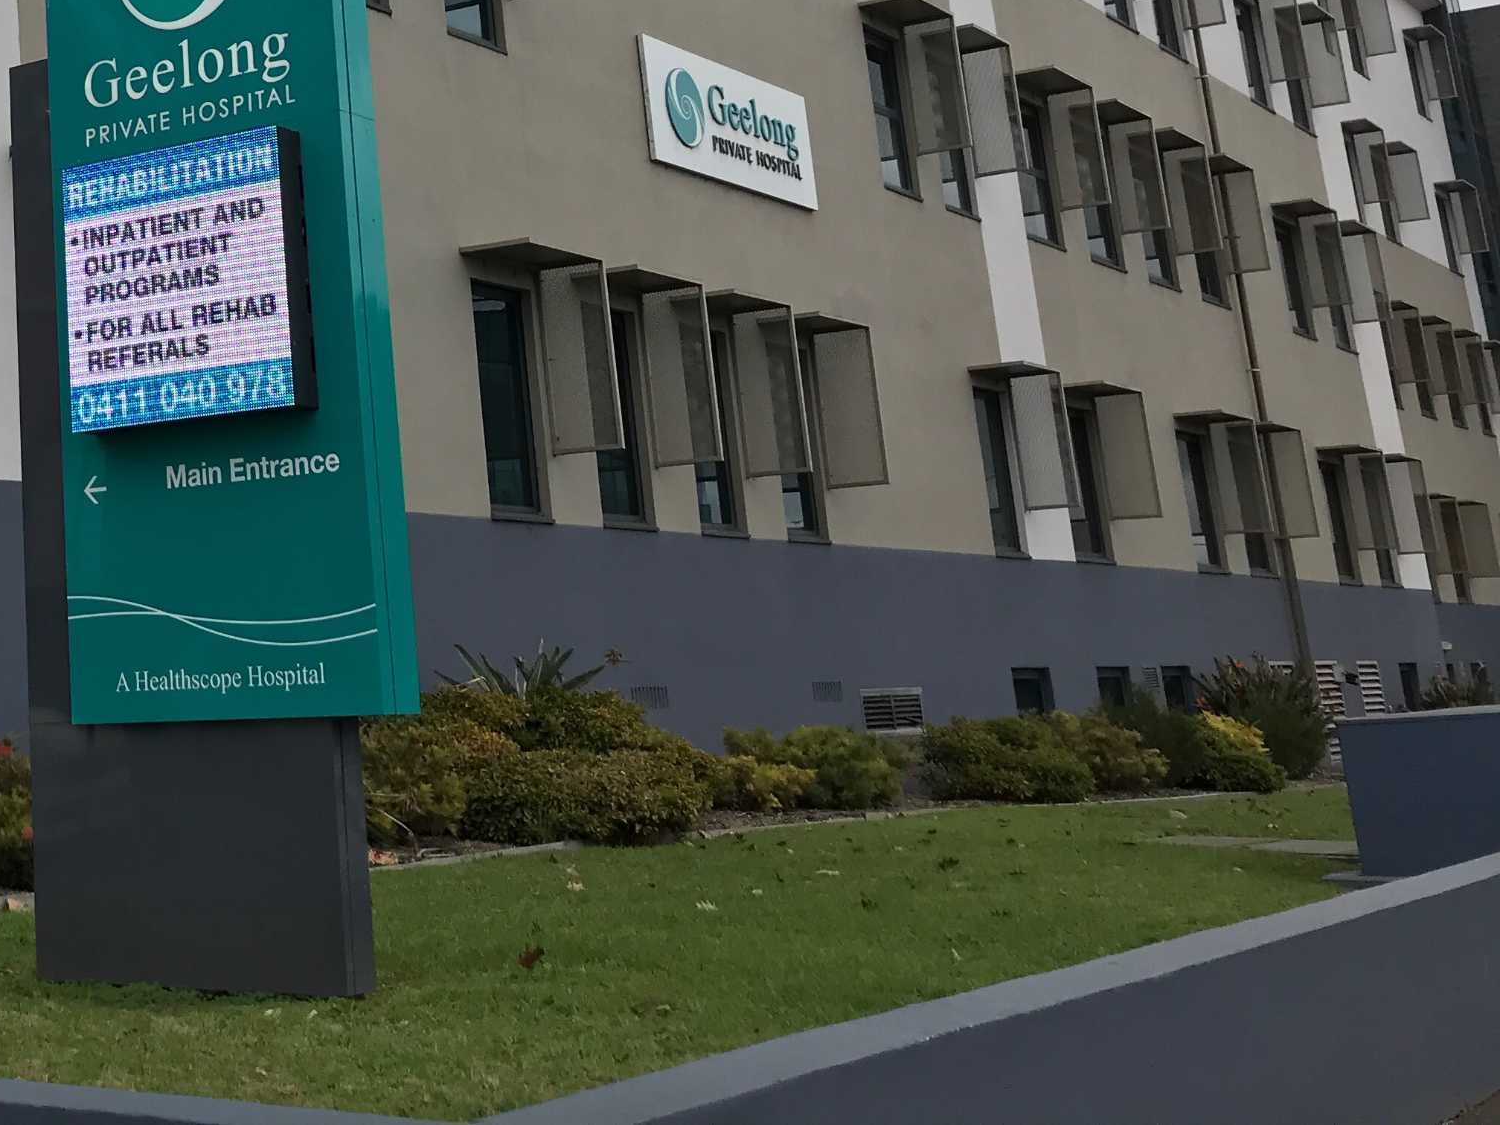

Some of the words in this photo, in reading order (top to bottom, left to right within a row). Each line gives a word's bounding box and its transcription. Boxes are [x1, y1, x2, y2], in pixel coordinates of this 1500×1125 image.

[84, 32, 291, 108] Geelong
[85, 111, 171, 147] PRIVATE
[182, 84, 296, 127] HOSPITAL
[708, 85, 799, 161] Geelong
[67, 143, 274, 208] REHABILITATION
[712, 135, 754, 163] PRIVATE
[756, 150, 802, 181] HOSPITAL
[83, 207, 204, 249] INPATIENT
[213, 196, 265, 223] AND
[84, 232, 232, 276] OUTPATIENT
[85, 264, 219, 304] PROGRAMS
[86, 317, 133, 343] FOR
[140, 308, 184, 335] ALL
[192, 293, 277, 328] REHAB
[88, 333, 210, 372] REFERALS
[78, 386, 147, 424] 0411
[160, 376, 217, 412] 040
[227, 365, 287, 405] 978
[166, 463, 222, 489] Main
[230, 451, 341, 483] Entrance
[116, 672, 131, 692] A
[135, 668, 242, 694] Healthscope
[248, 662, 326, 693] Hospital
